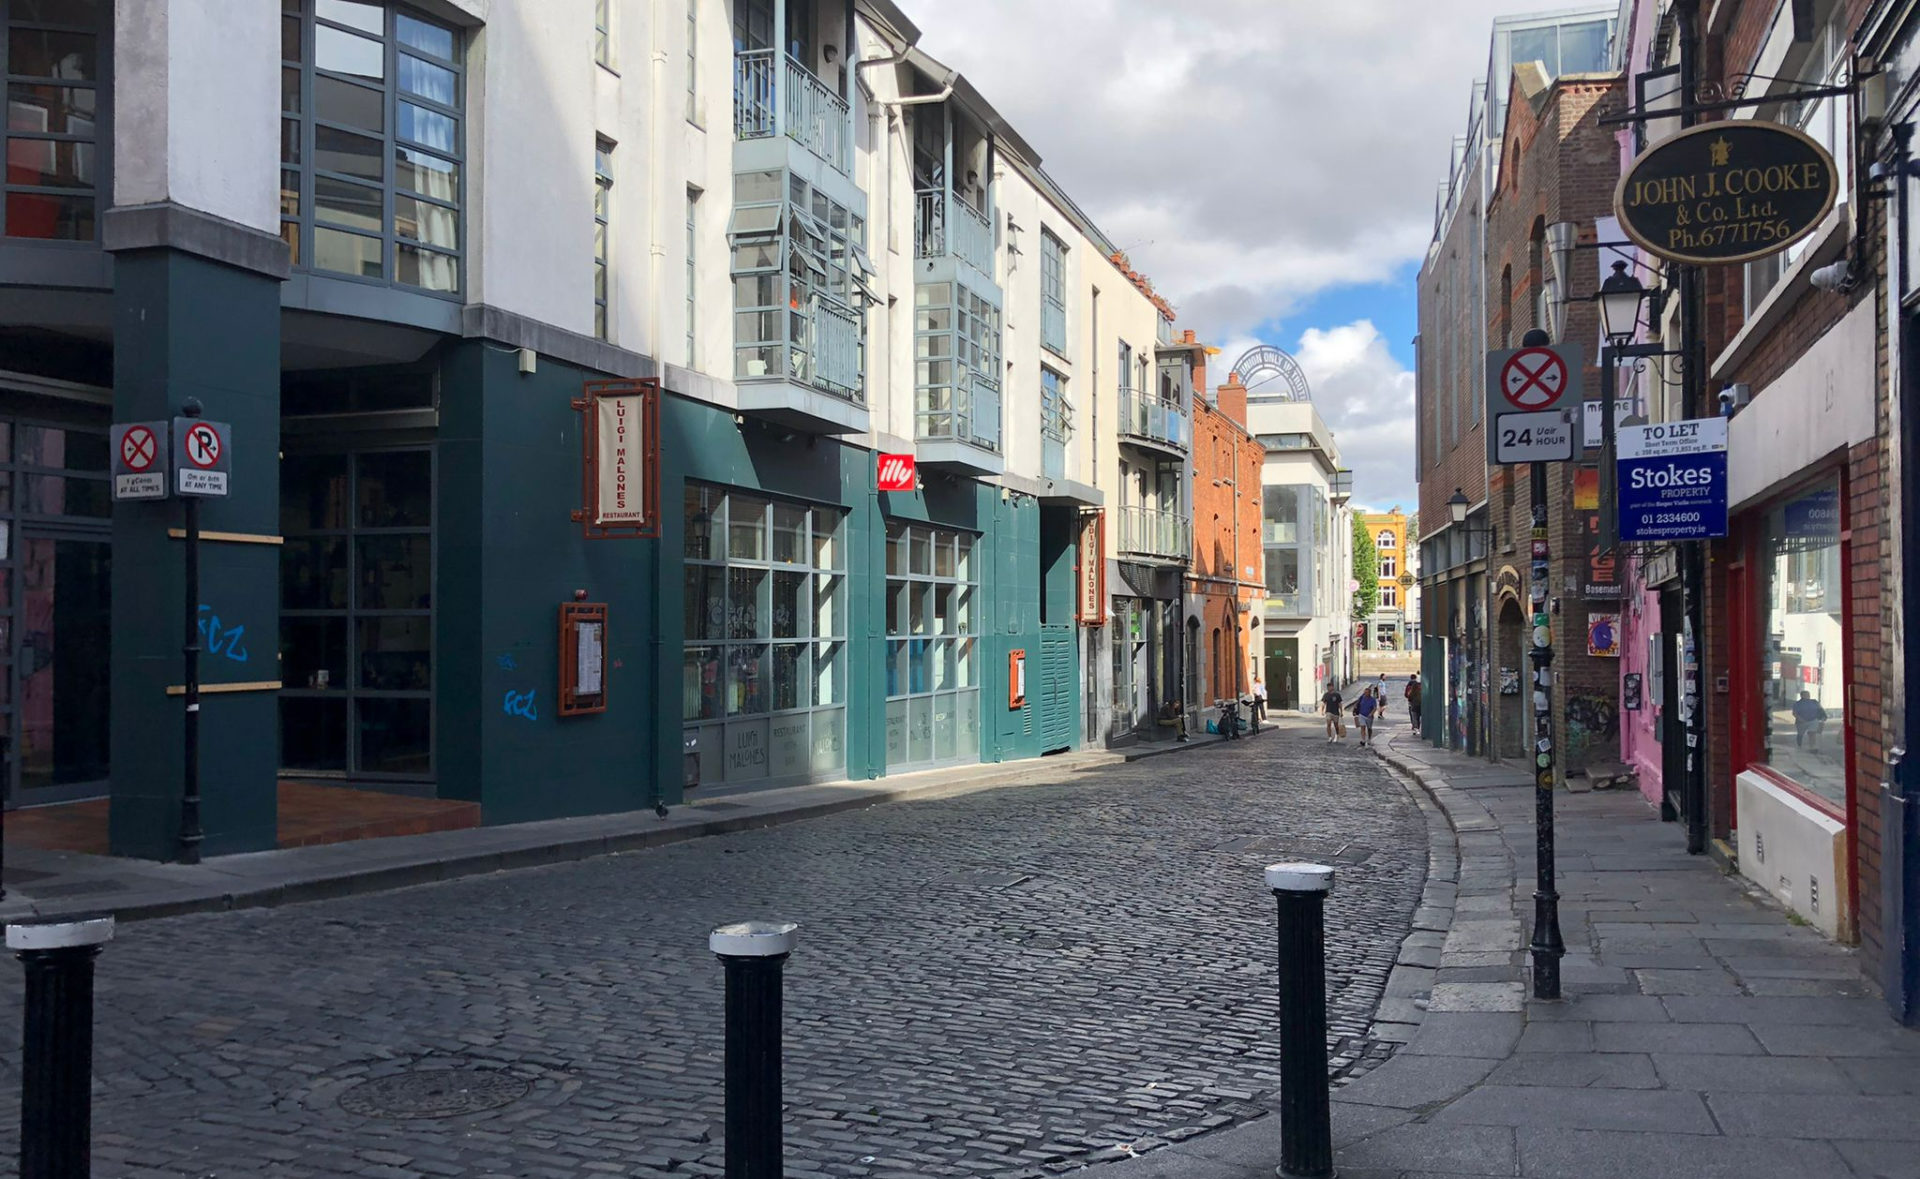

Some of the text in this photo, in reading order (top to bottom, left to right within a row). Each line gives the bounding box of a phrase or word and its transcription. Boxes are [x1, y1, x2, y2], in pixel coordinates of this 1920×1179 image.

[1630, 175, 1696, 207] JOHN
[1725, 163, 1820, 194] COOKE
[1676, 197, 1778, 226] & Co. Ltd.
[1264, 352, 1283, 366] ONLY
[1503, 428, 1533, 447] 24
[1536, 427, 1557, 436] Uair
[1643, 422, 1700, 440] TO LET
[1536, 436, 1566, 446] HOUR
[617, 400, 625, 509] LUIGI MALONES
[880, 459, 912, 488] illy
[1631, 464, 1712, 489] Stokes
[1661, 487, 1711, 498] PROPERTY
[602, 511, 641, 519] RESTAURANT
[1641, 511, 1700, 524] 01 2334600
[1636, 524, 1706, 536] stokesproperty.ie
[1585, 583, 1622, 594] Basement
[729, 748, 765, 769] MALONES
